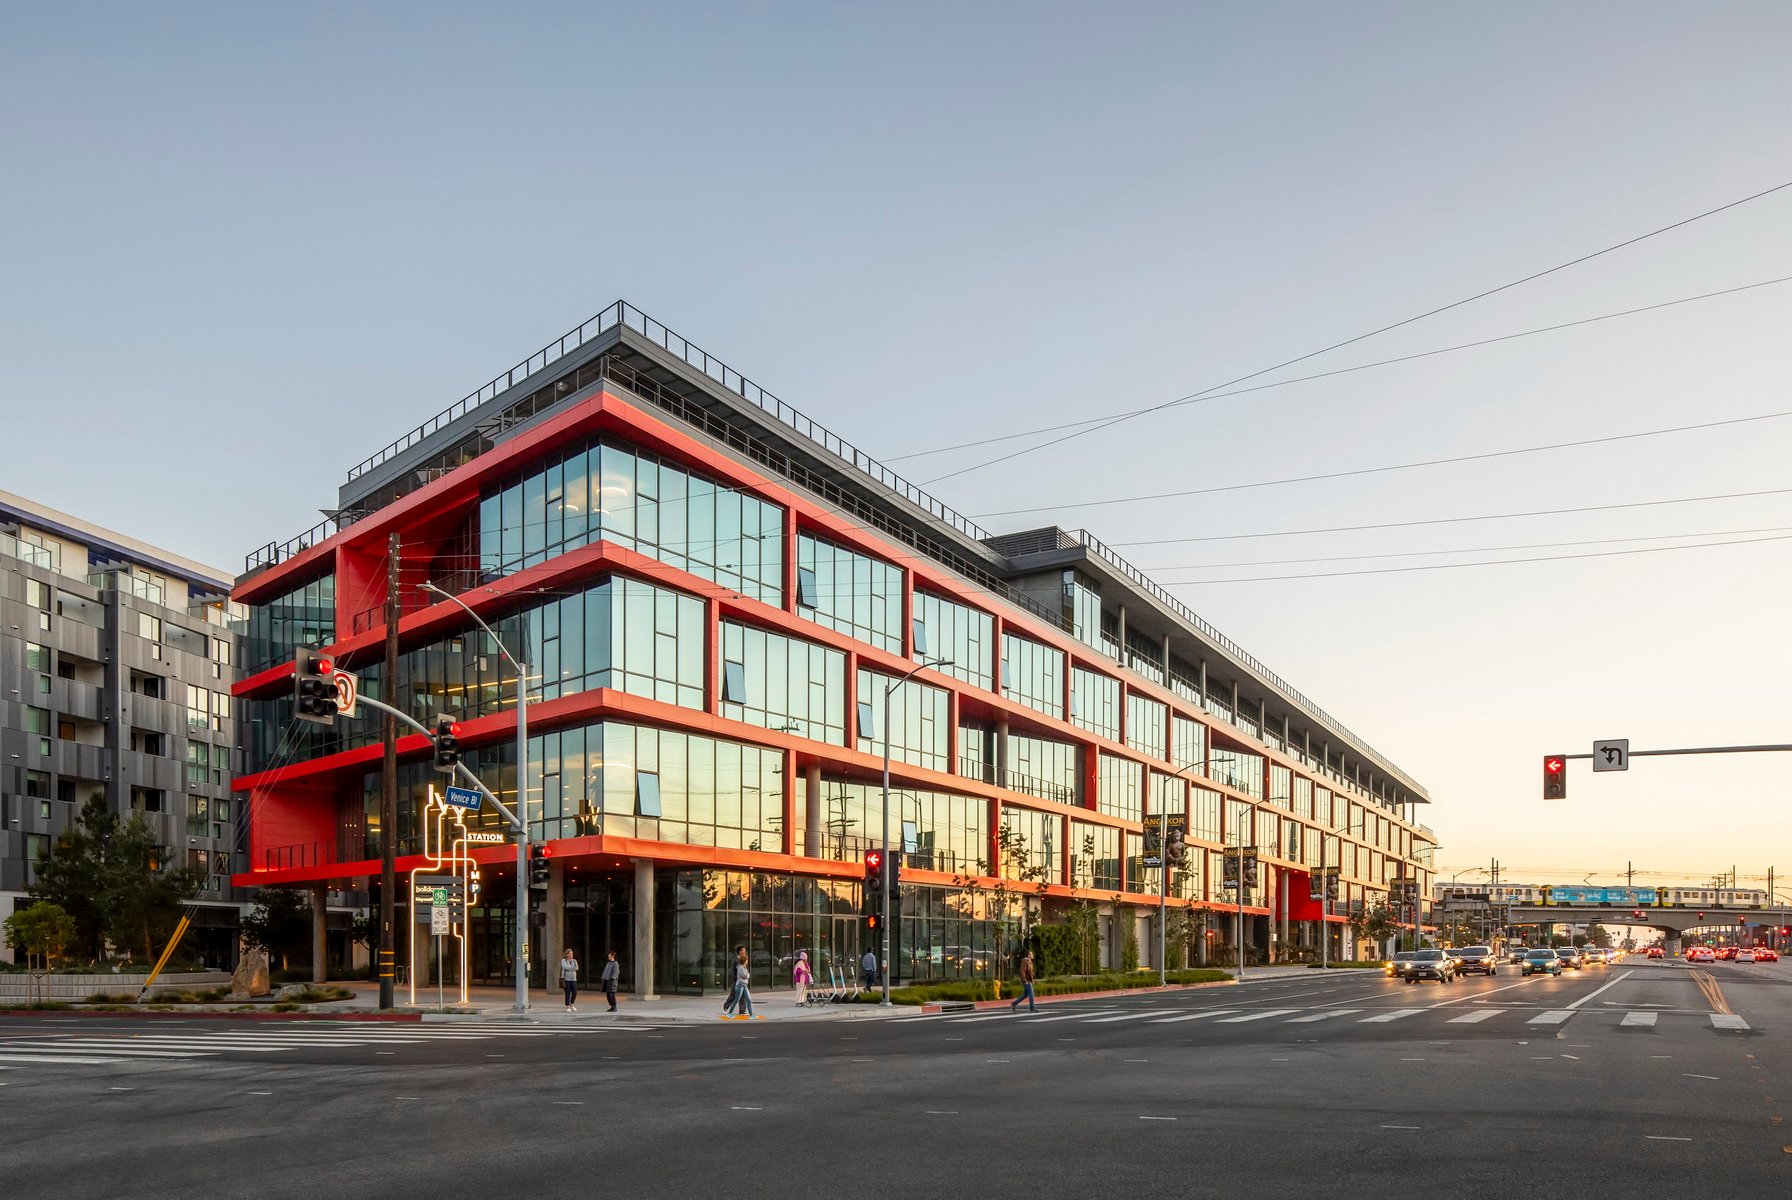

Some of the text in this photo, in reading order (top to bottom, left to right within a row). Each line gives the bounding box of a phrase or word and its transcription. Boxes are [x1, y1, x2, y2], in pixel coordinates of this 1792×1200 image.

[450, 791, 478, 805] Venice Bl
[467, 833, 503, 841] STATION
[471, 883, 479, 893] P
